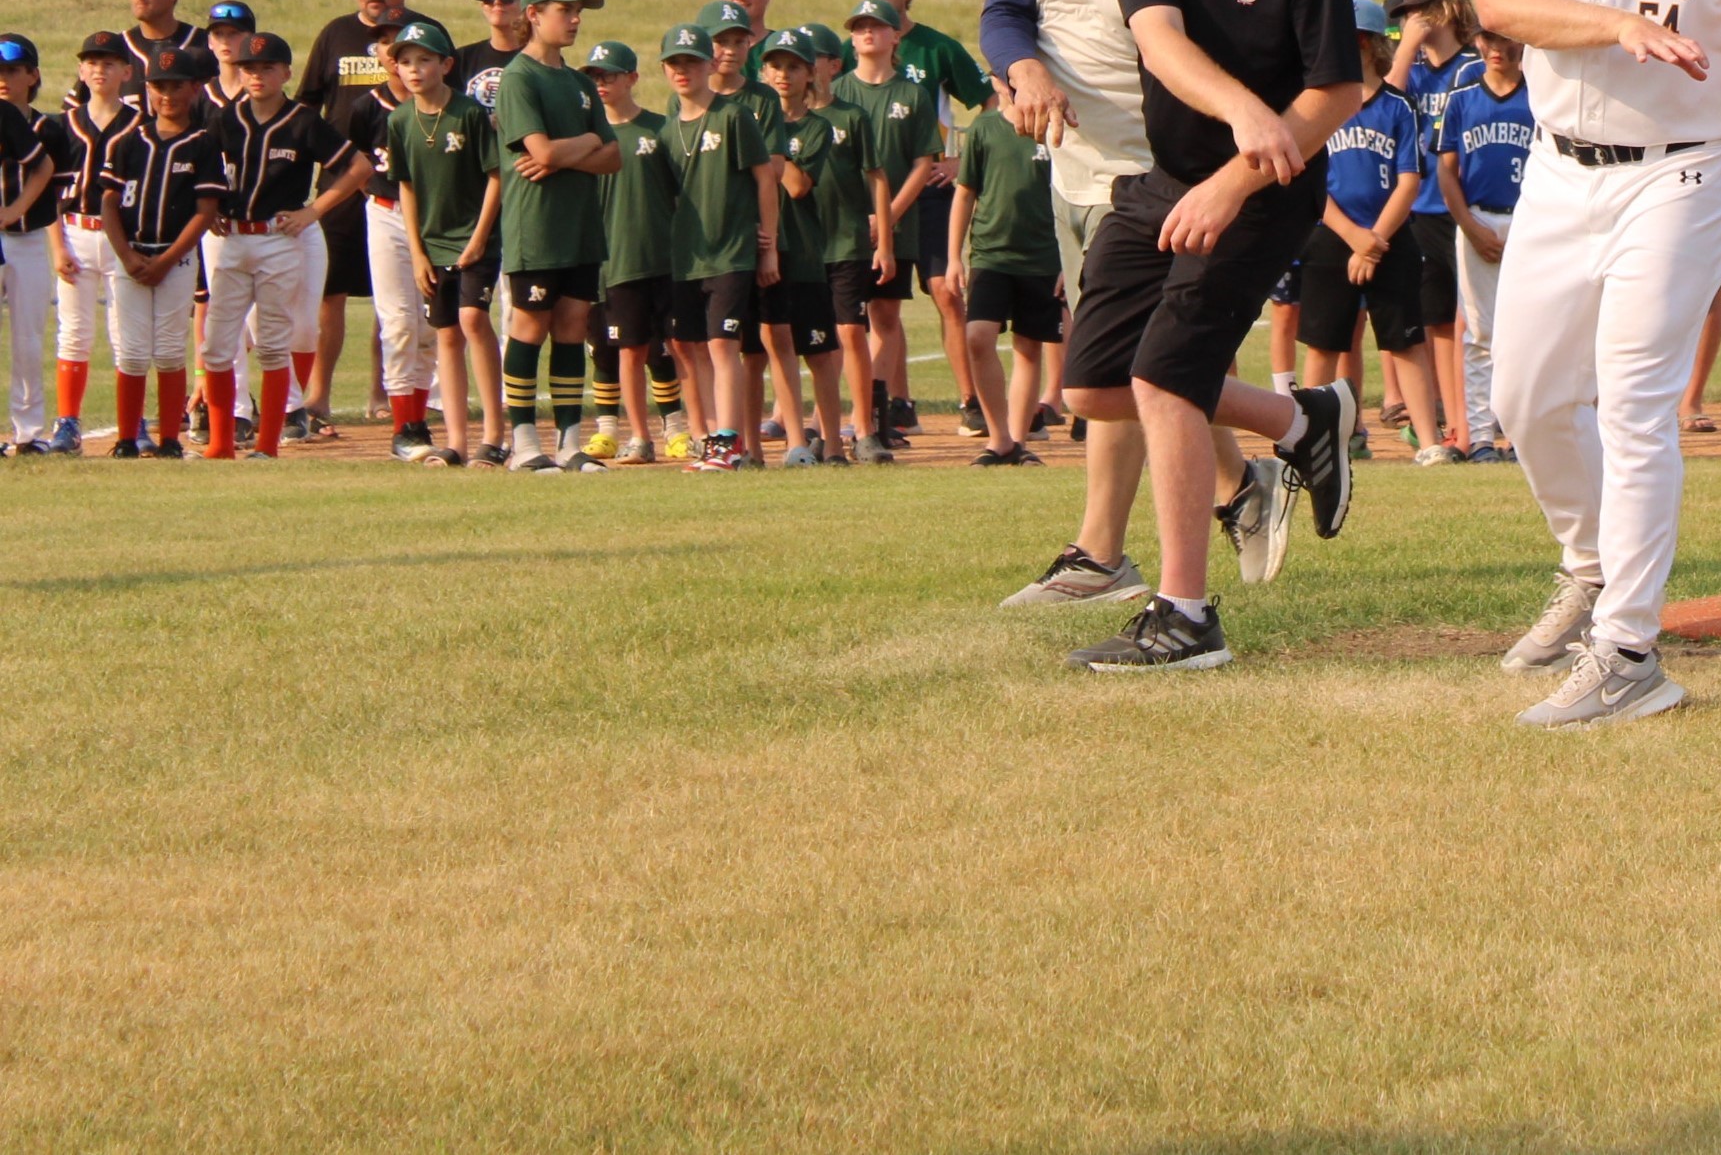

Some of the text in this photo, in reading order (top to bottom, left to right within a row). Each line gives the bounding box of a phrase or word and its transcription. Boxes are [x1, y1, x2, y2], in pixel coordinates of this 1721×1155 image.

[1379, 164, 1390, 190] 9
[608, 325, 619, 340] 21
[723, 318, 739, 333] 27
